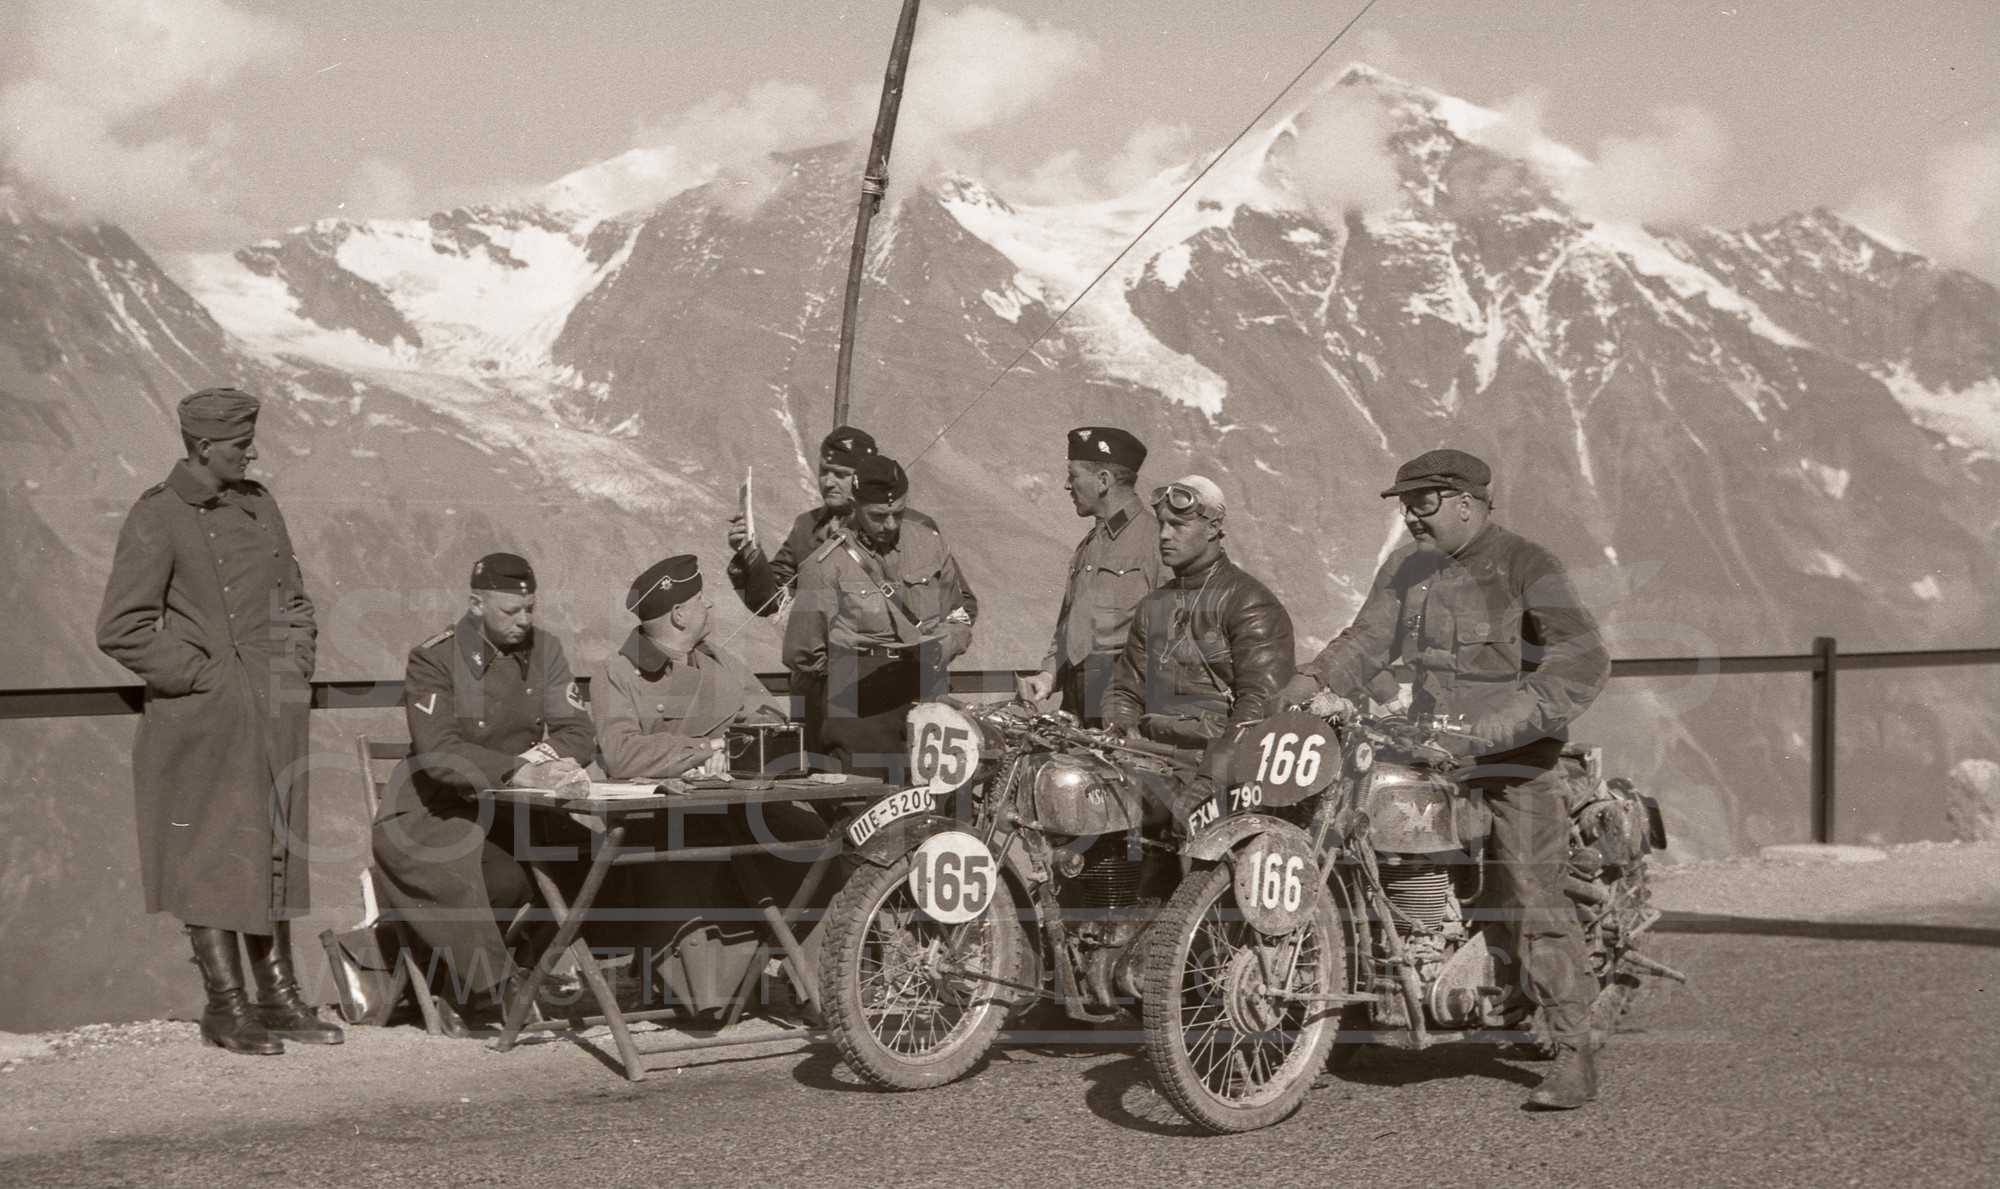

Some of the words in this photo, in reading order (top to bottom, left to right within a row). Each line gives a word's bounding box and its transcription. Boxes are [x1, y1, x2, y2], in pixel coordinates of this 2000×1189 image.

[1256, 732, 1326, 787] 166
[1187, 797, 1220, 836] FXM
[1230, 785, 1262, 812] 790
[910, 851, 989, 913] 165
[1250, 851, 1304, 912] 166
